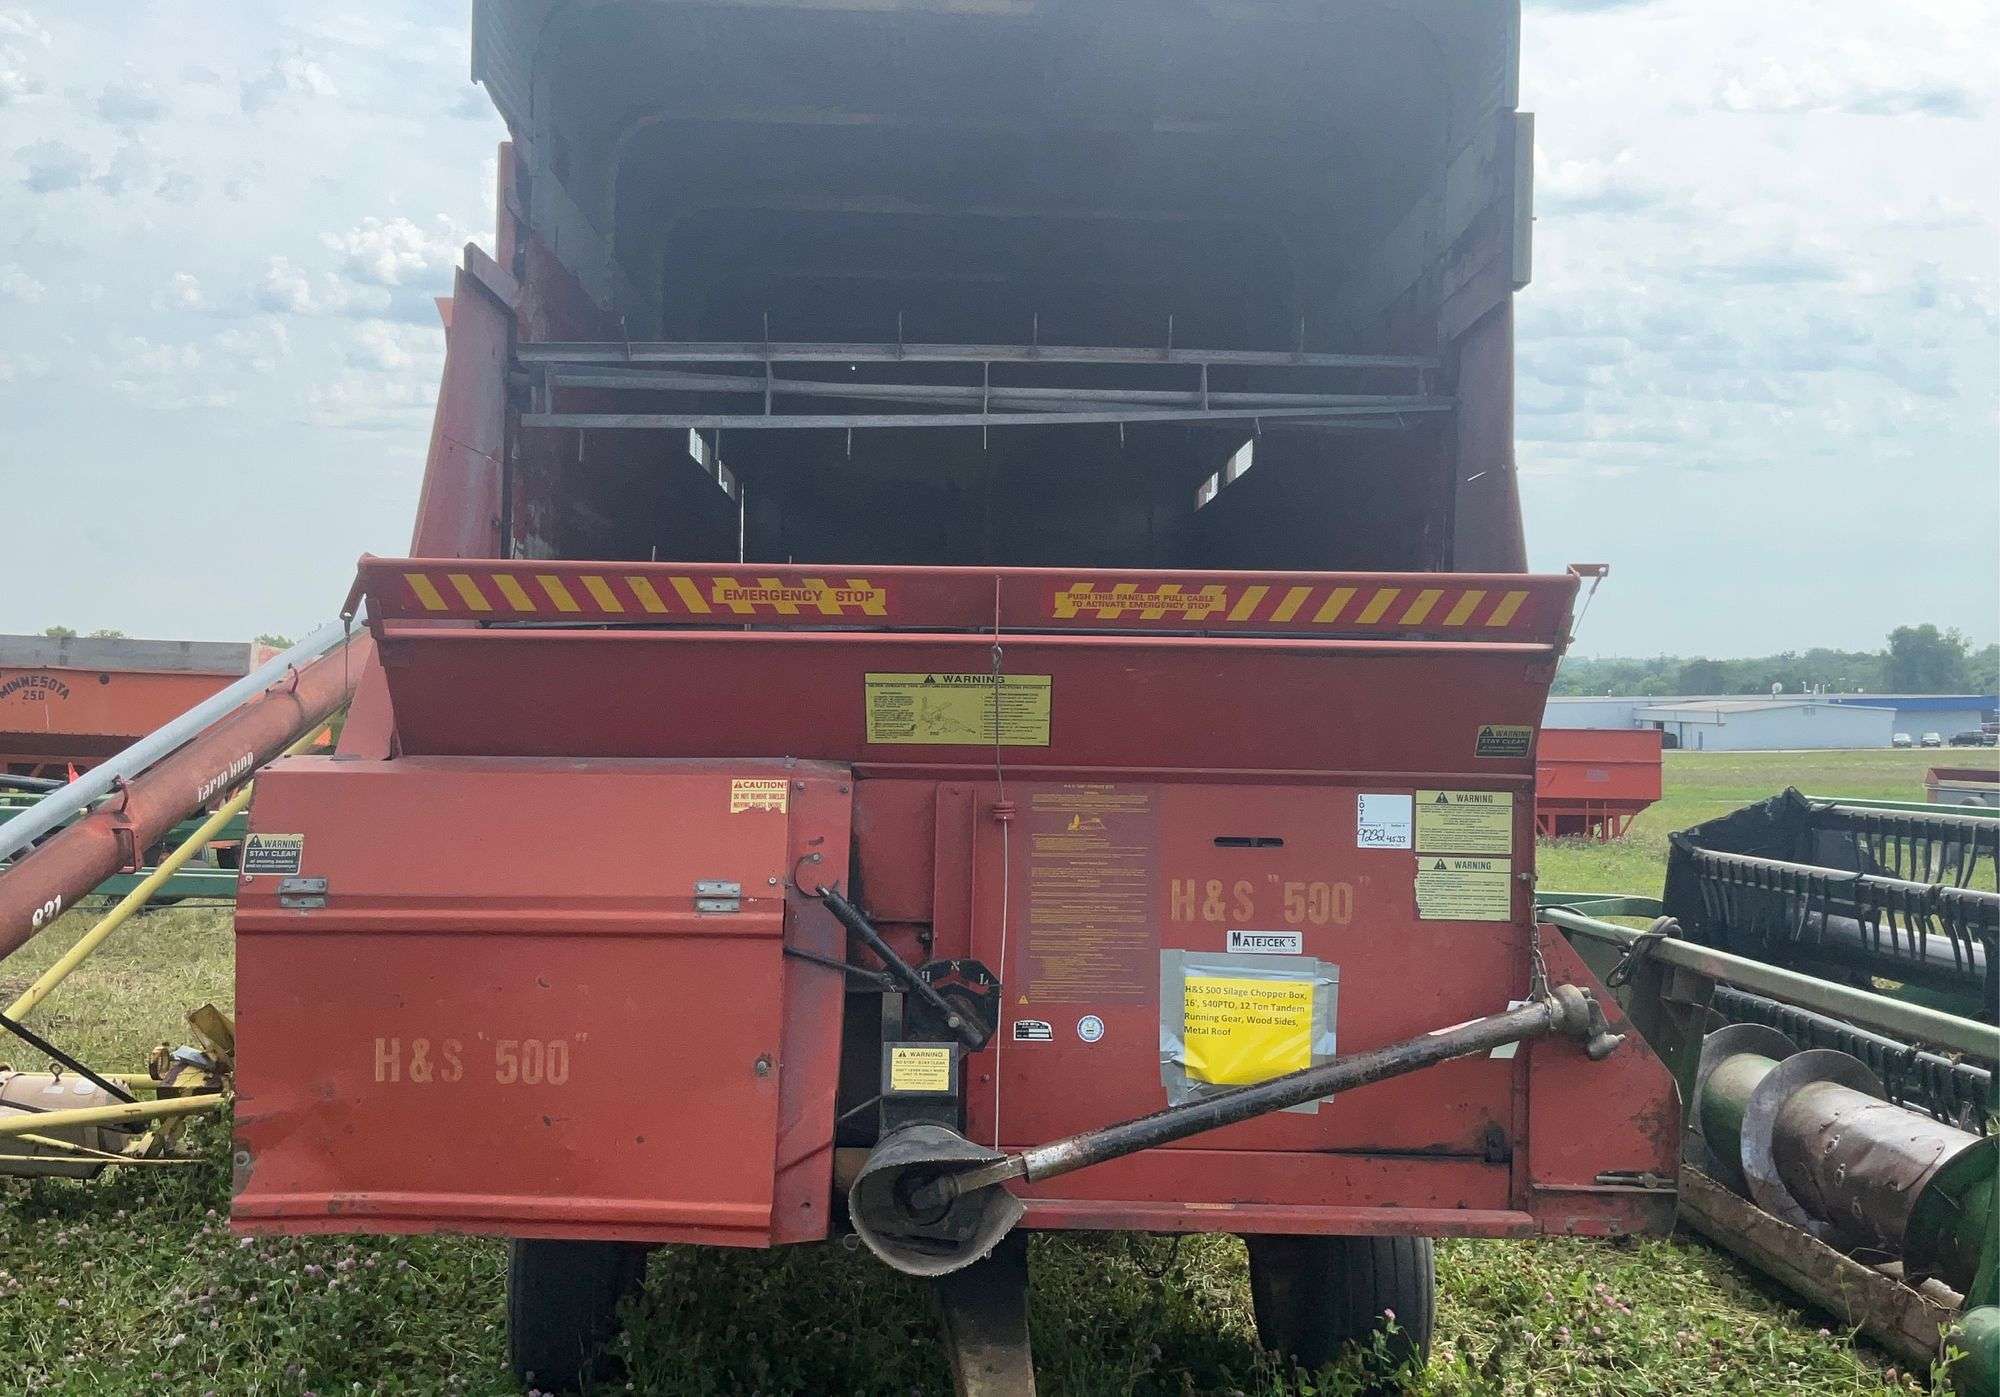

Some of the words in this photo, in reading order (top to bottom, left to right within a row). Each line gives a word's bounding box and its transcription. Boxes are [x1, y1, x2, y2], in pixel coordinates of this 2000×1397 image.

[723, 589, 823, 601] EMERGENCY
[836, 590, 875, 602] STOP
[943, 675, 1006, 684] WARNING
[0, 675, 70, 701] MINNESOTA
[22, 689, 46, 700] 250
[1456, 794, 1493, 803] WARNING
[264, 839, 302, 848] WARNING
[1454, 861, 1492, 870] WARNING
[1185, 985, 1203, 994] H&S
[1206, 986, 1221, 994] 500
[1223, 987, 1249, 998] Silage
[1250, 988, 1287, 999] Chopper
[1289, 991, 1308, 1000] Box,
[1240, 1002, 1250, 1010] 12
[1253, 1003, 1269, 1011] Ton
[1270, 1003, 1305, 1013] Tandem
[1184, 1012, 1219, 1023] Running
[1221, 1014, 1244, 1024] Gear,
[1246, 1016, 1272, 1024] Wood
[1274, 1017, 1299, 1027] Sides,
[1184, 1026, 1209, 1035] Metal
[1211, 1027, 1231, 1036] Roof
